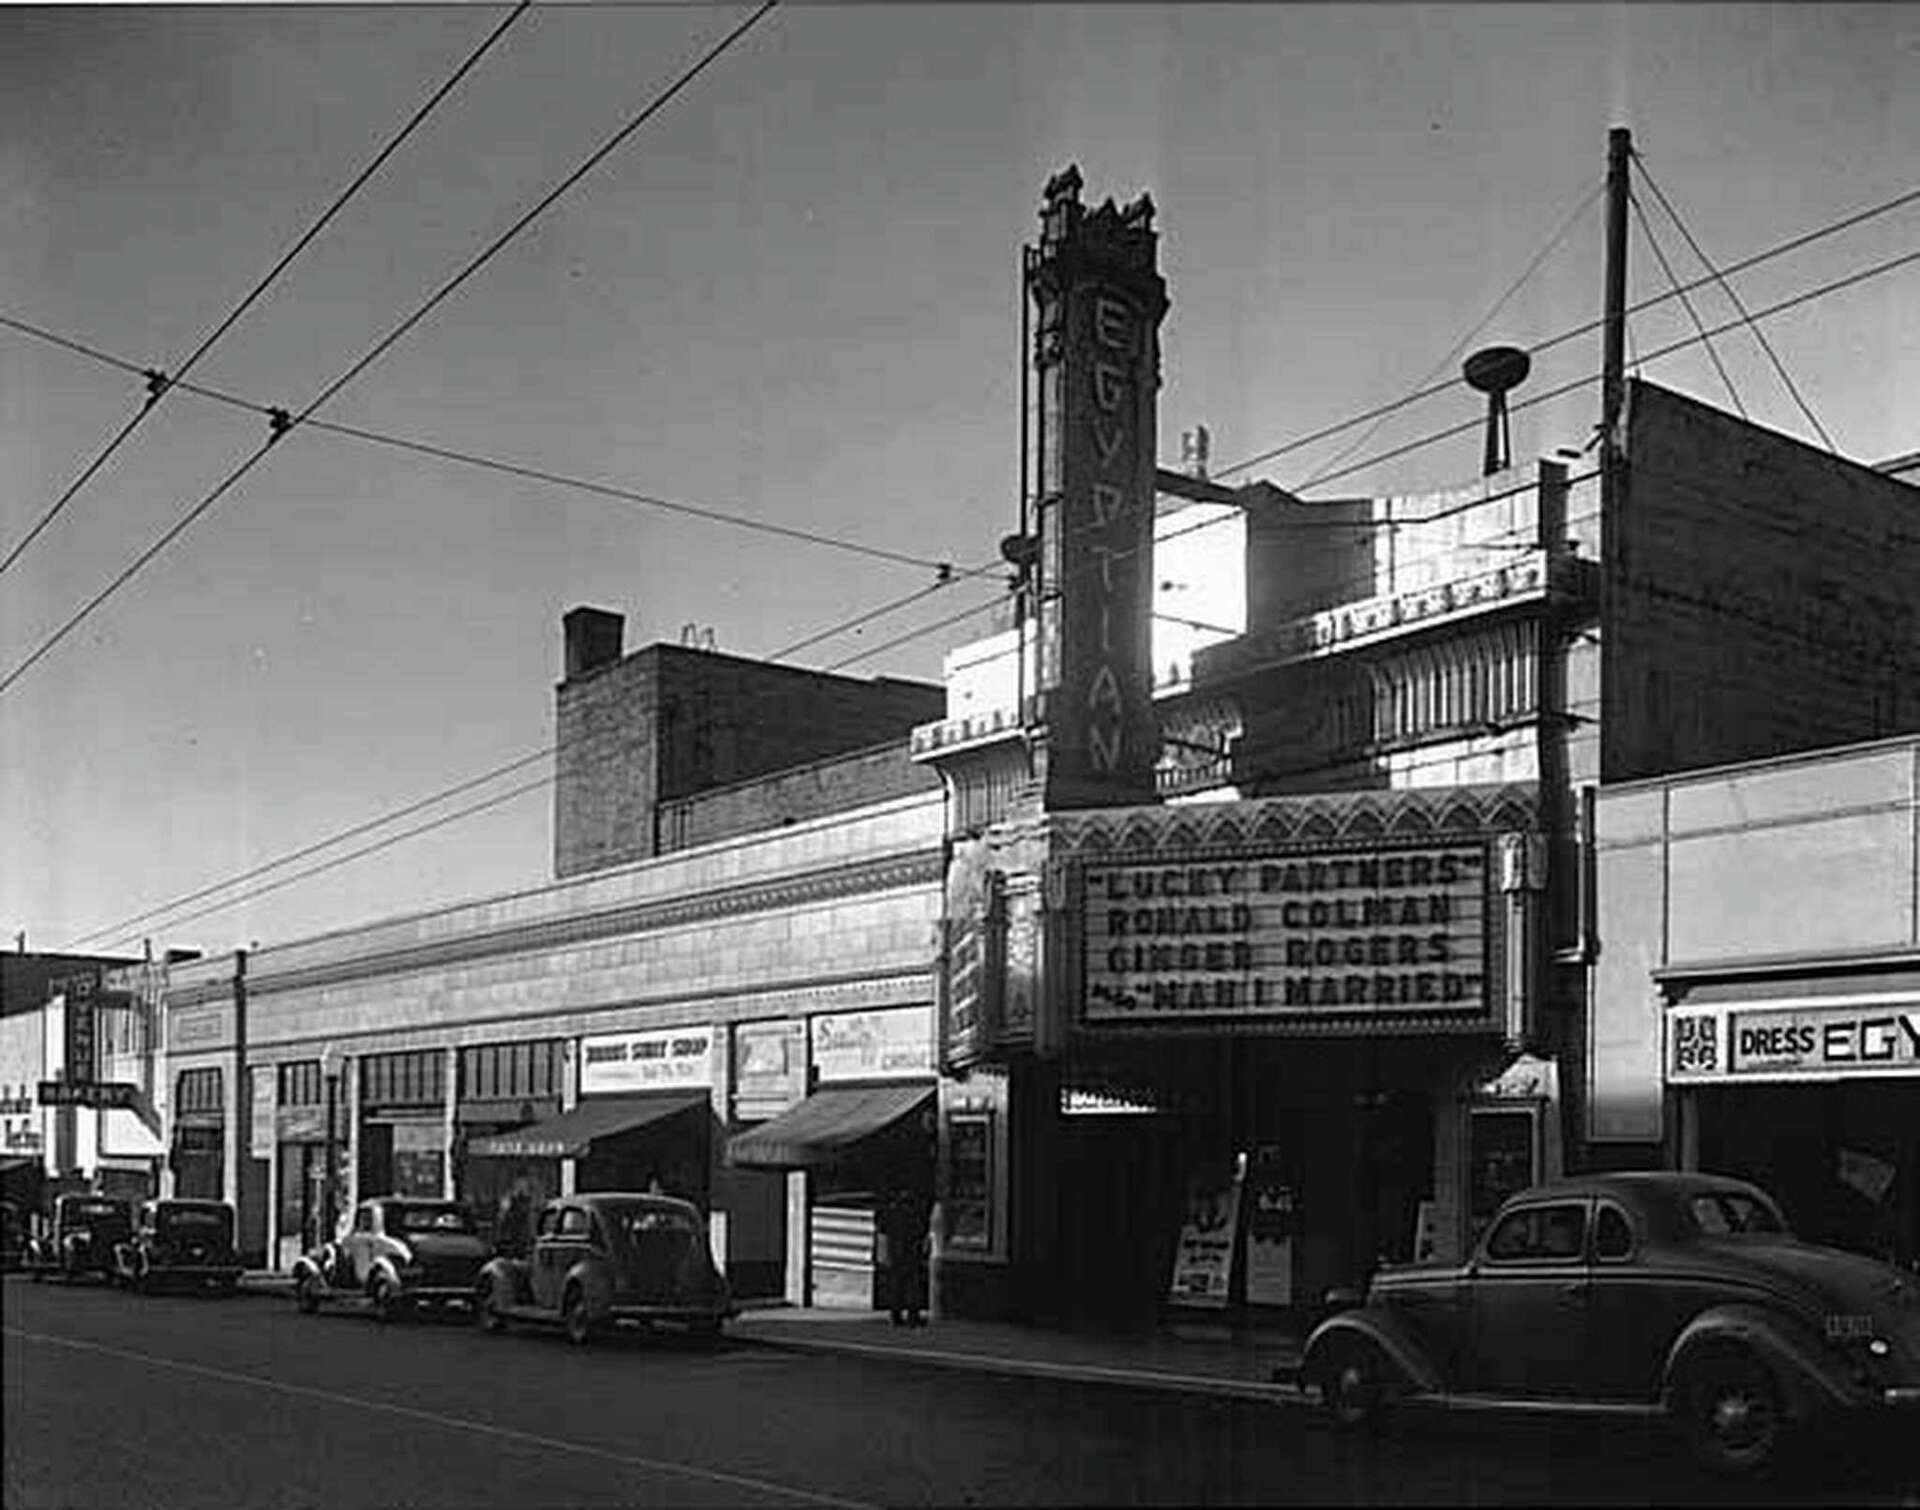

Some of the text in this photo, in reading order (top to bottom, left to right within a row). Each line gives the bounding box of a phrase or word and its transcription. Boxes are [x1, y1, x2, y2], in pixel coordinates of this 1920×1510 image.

[1090, 299, 1133, 771] EGYPTIAN
[1108, 894, 1449, 936] RONALD COLMAN
[1285, 933, 1449, 966] ROGERS
[1740, 1026, 1815, 1056] DRESS
